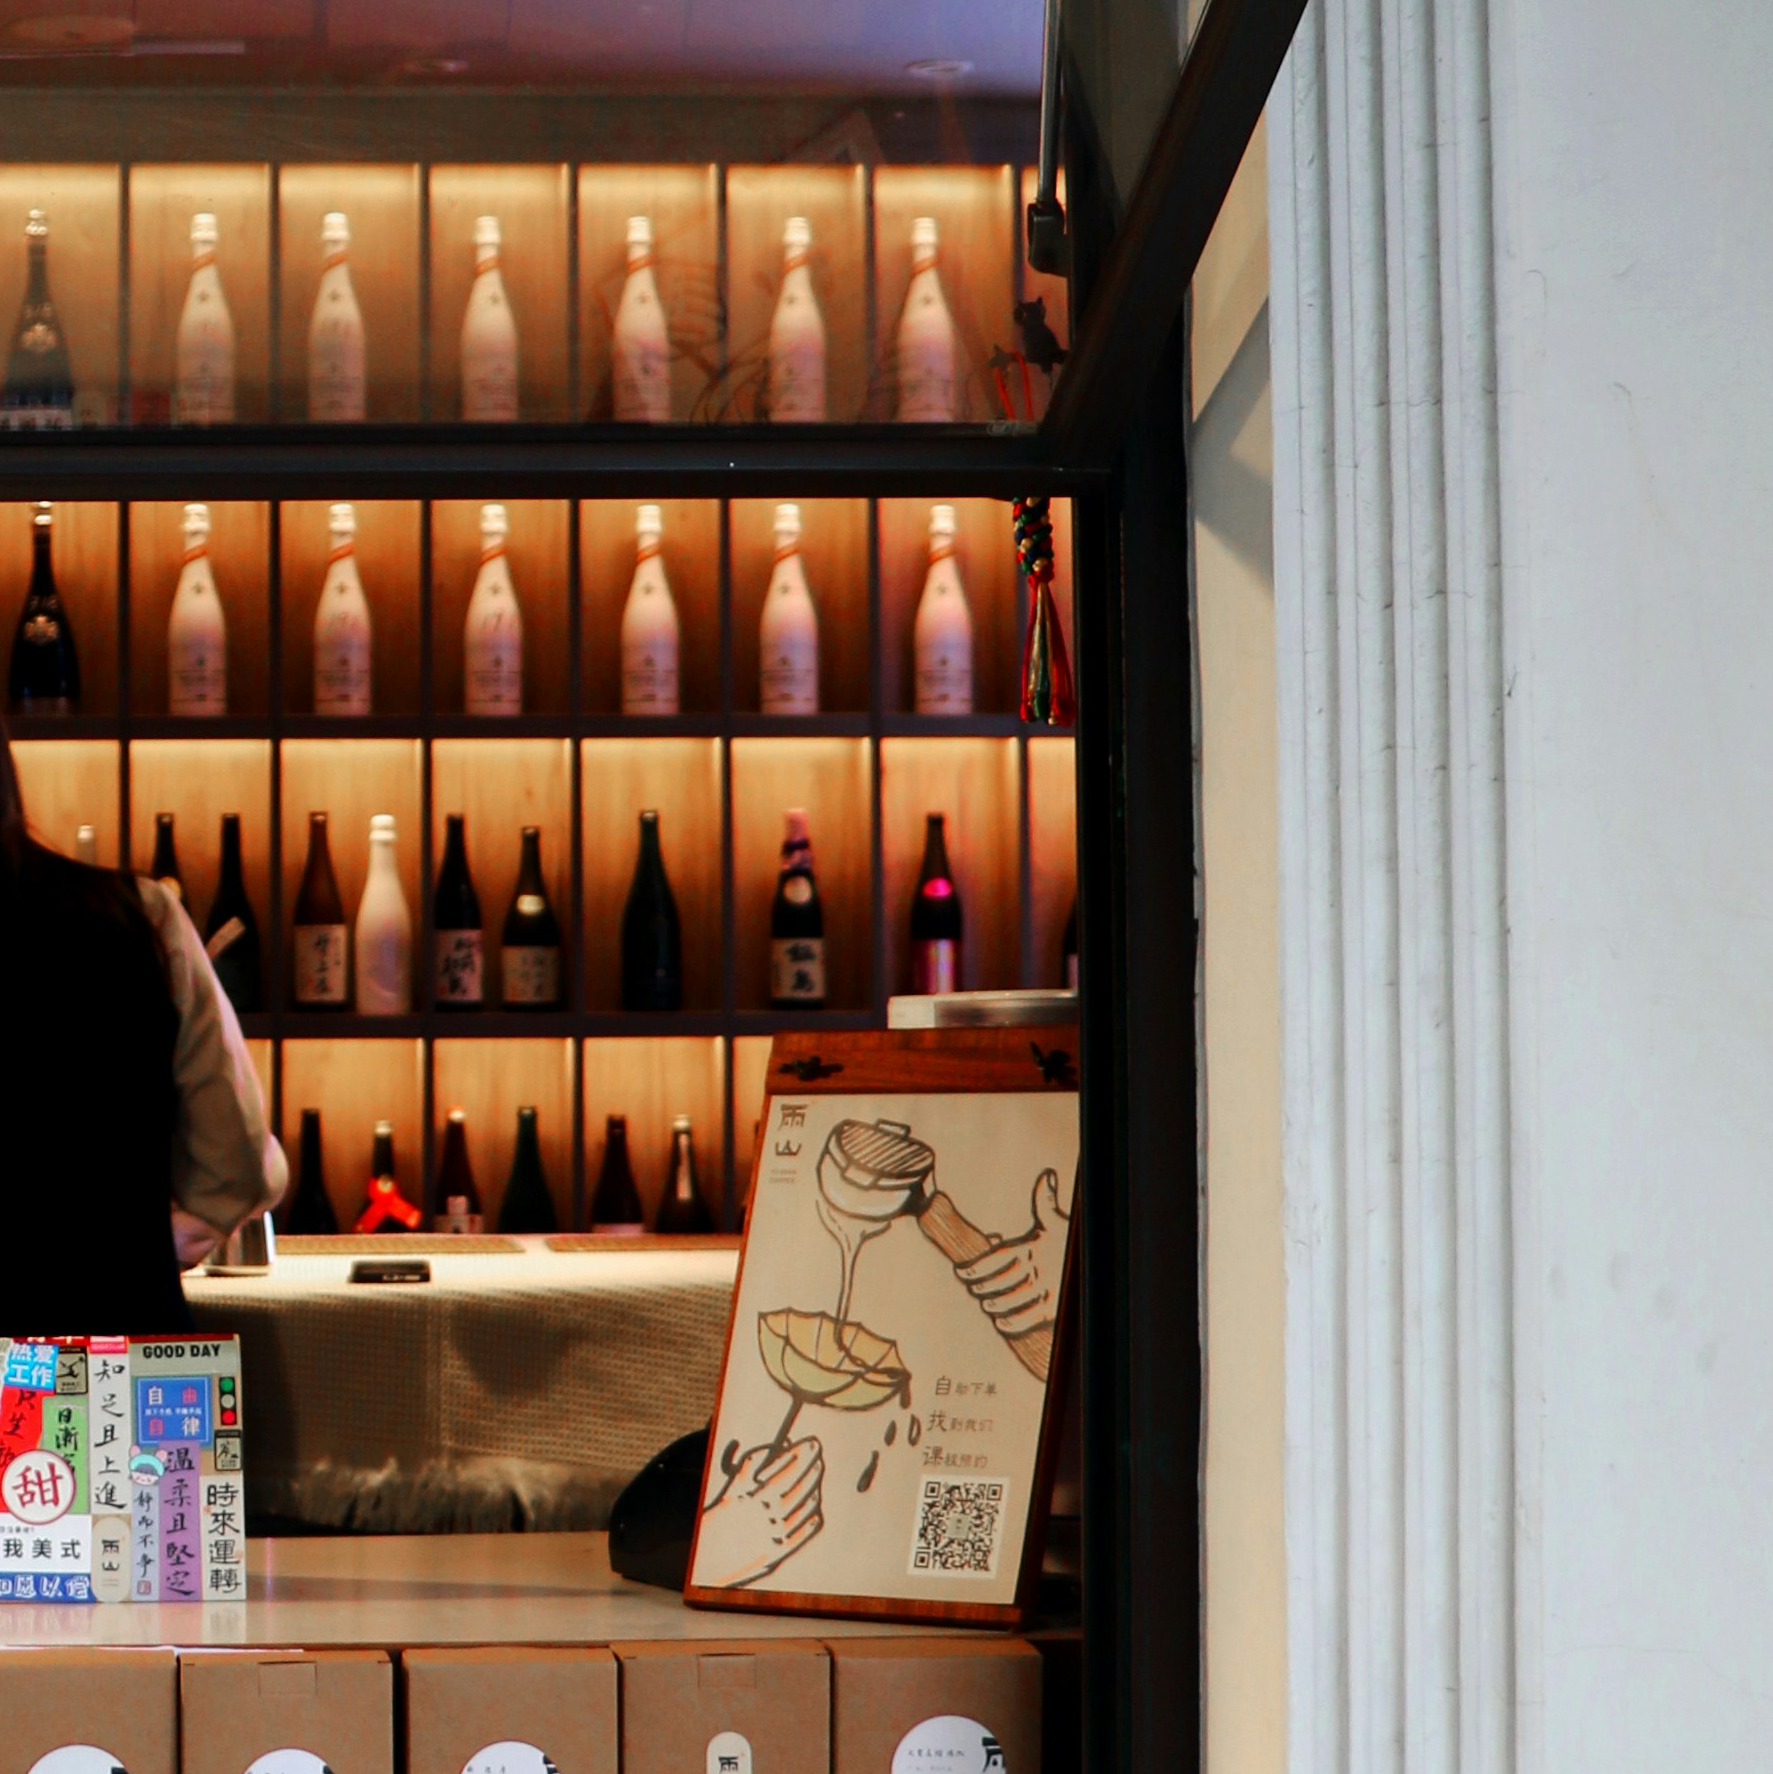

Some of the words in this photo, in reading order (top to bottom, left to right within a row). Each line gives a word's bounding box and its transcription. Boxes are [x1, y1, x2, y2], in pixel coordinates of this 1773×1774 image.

[143, 1345, 186, 1358] GOOD
[190, 1344, 221, 1357] DAY
[8, 1363, 53, 1387] 工作
[11, 1461, 64, 1508] 甜
[3, 1538, 81, 1559] 我美式
